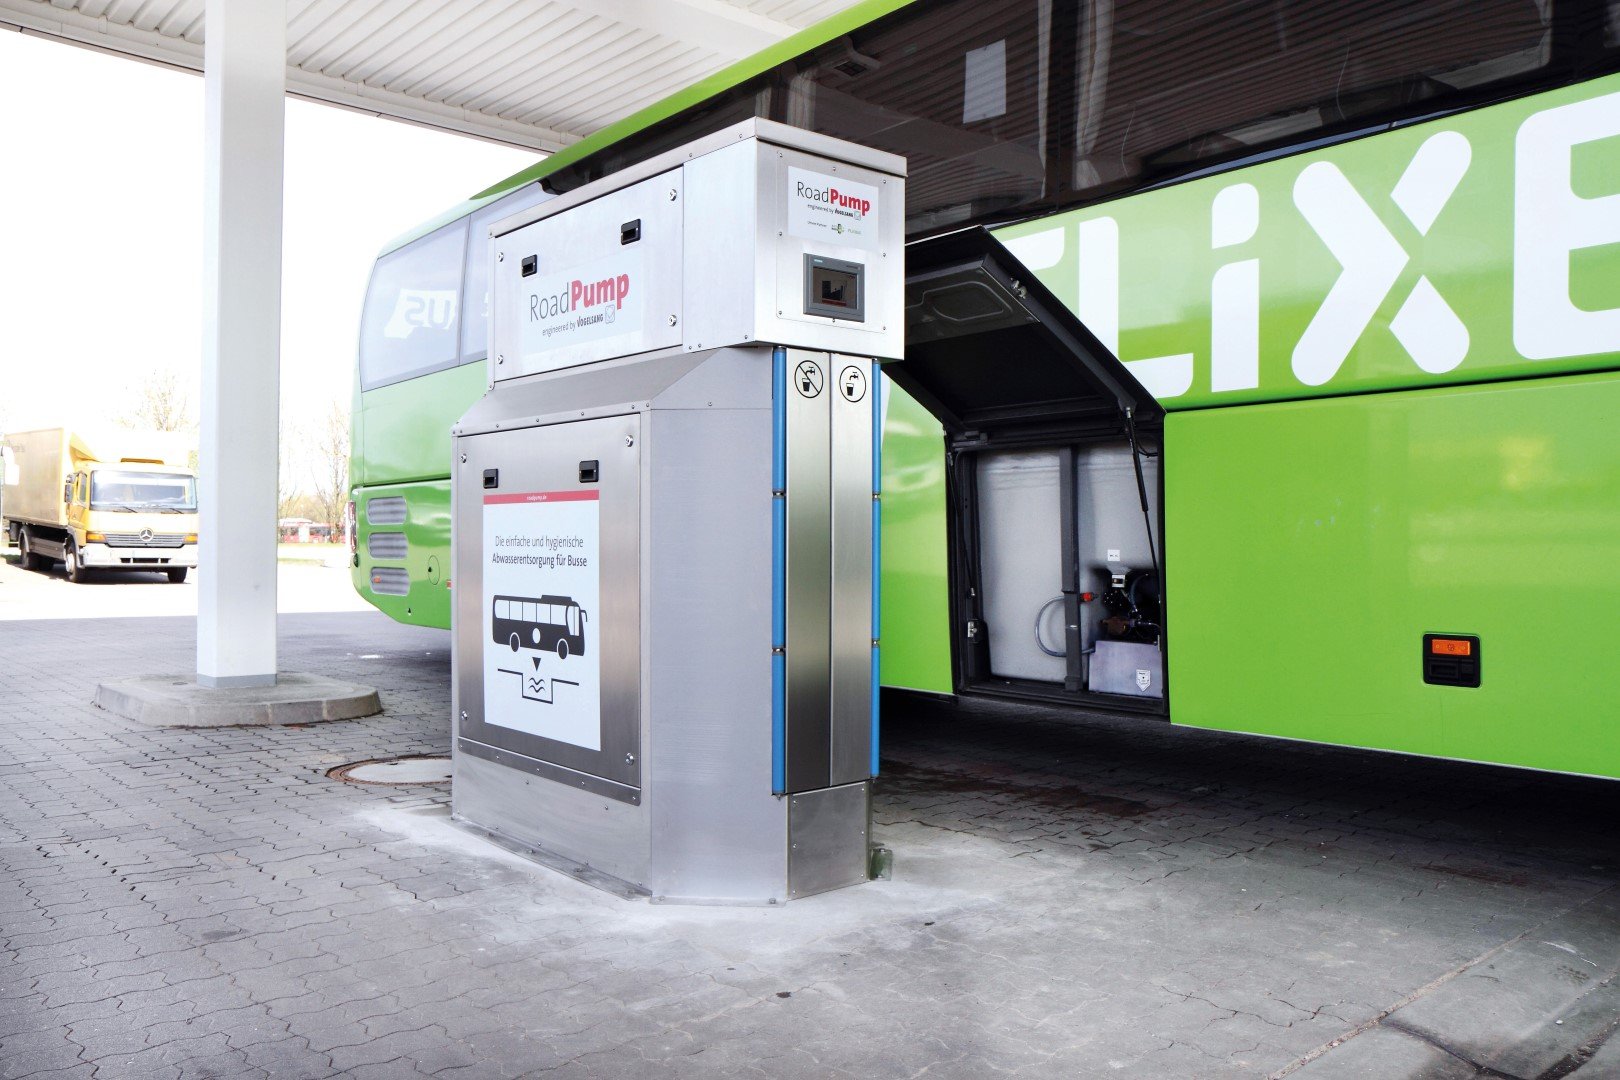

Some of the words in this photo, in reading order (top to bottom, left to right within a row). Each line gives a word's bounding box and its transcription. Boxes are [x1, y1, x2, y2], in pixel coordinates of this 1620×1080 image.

[797, 181, 870, 216] RoadPump
[530, 273, 630, 322] RoadPump
[542, 322, 569, 338] engineered
[569, 320, 576, 332] by
[576, 313, 604, 328] VOGELSANG
[495, 535, 505, 547] Die
[505, 535, 531, 547] einfache
[531, 535, 544, 547] und
[545, 535, 584, 551] hygienische
[492, 552, 555, 569] Abwasserentsorgung
[556, 553, 566, 566] für
[567, 554, 588, 567] Busse
